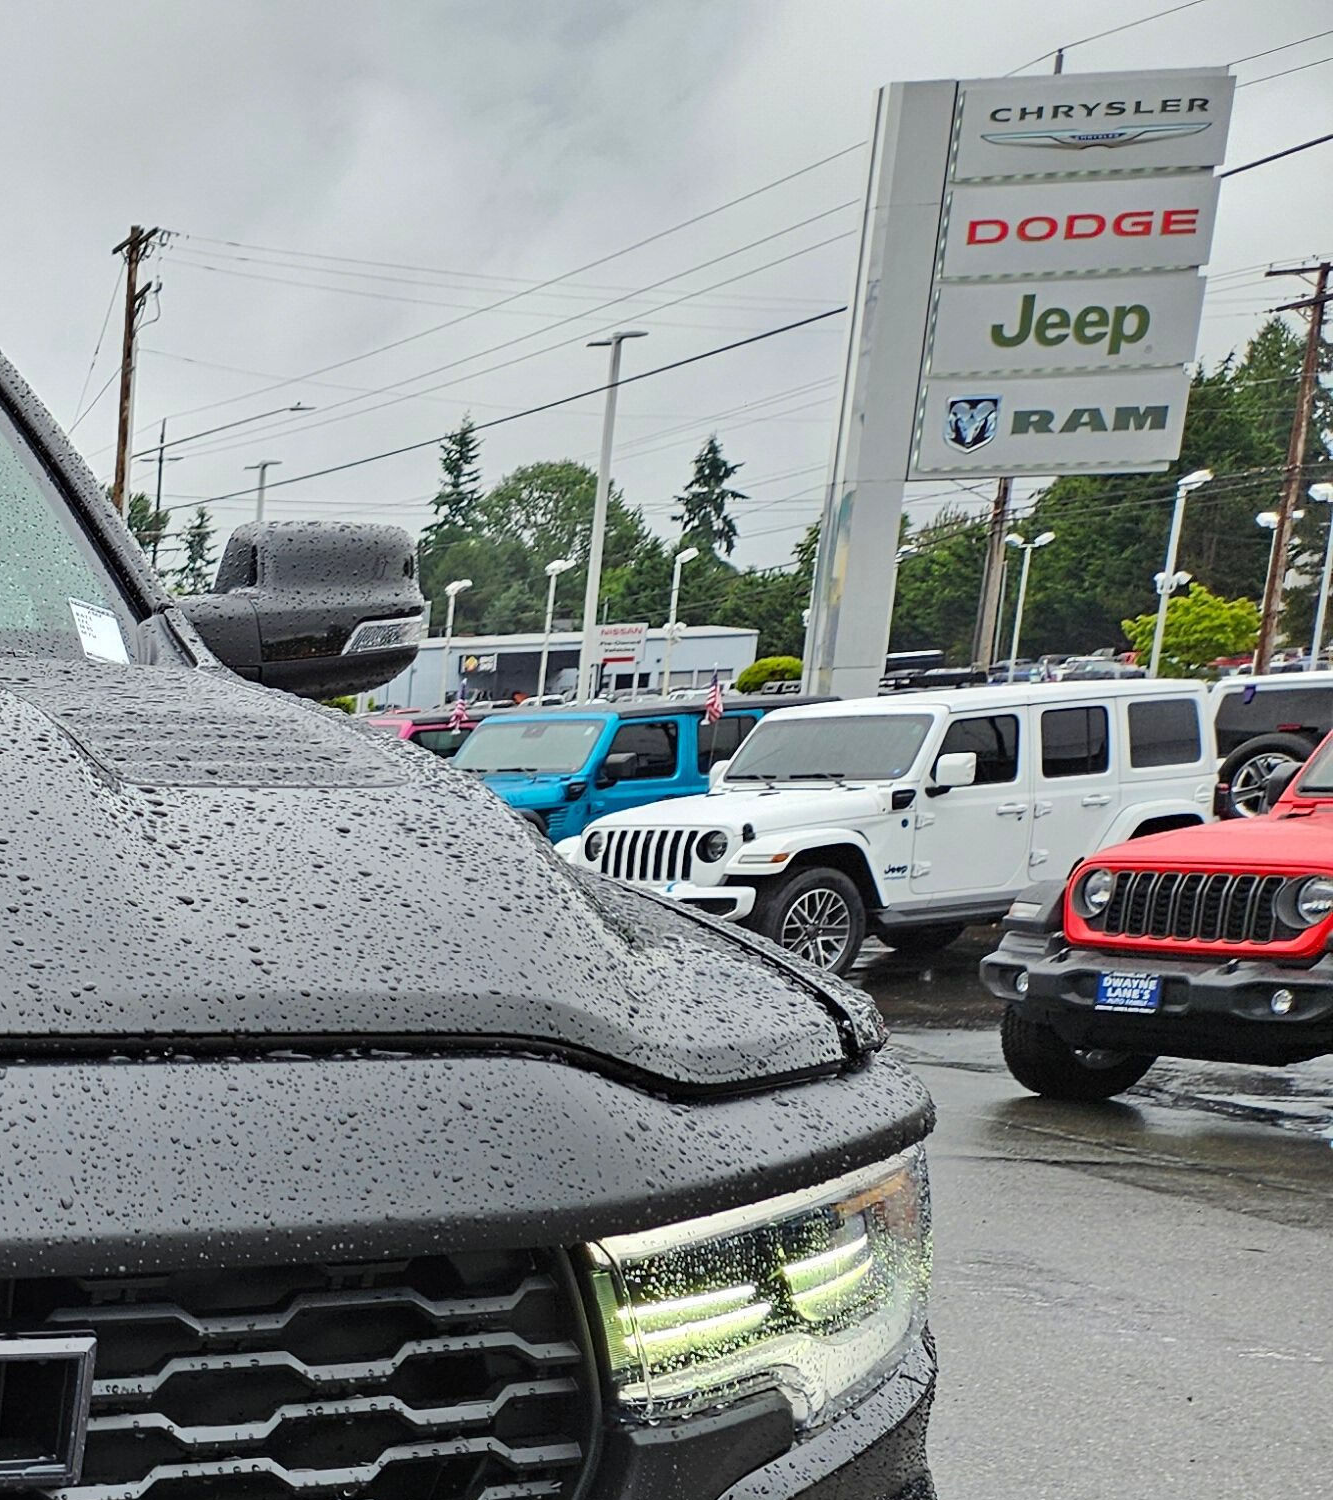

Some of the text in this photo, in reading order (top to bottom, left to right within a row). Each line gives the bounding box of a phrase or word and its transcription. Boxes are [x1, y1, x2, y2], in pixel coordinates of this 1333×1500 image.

[990, 97, 1210, 123] CHRYSLER
[966, 208, 1200, 246] DODGE
[991, 294, 1151, 356] Jeep
[1010, 405, 1170, 436] RAM
[599, 627, 644, 637] NISSAN
[1102, 976, 1158, 990] DWAYNE
[1106, 987, 1151, 1000] LANE'S
